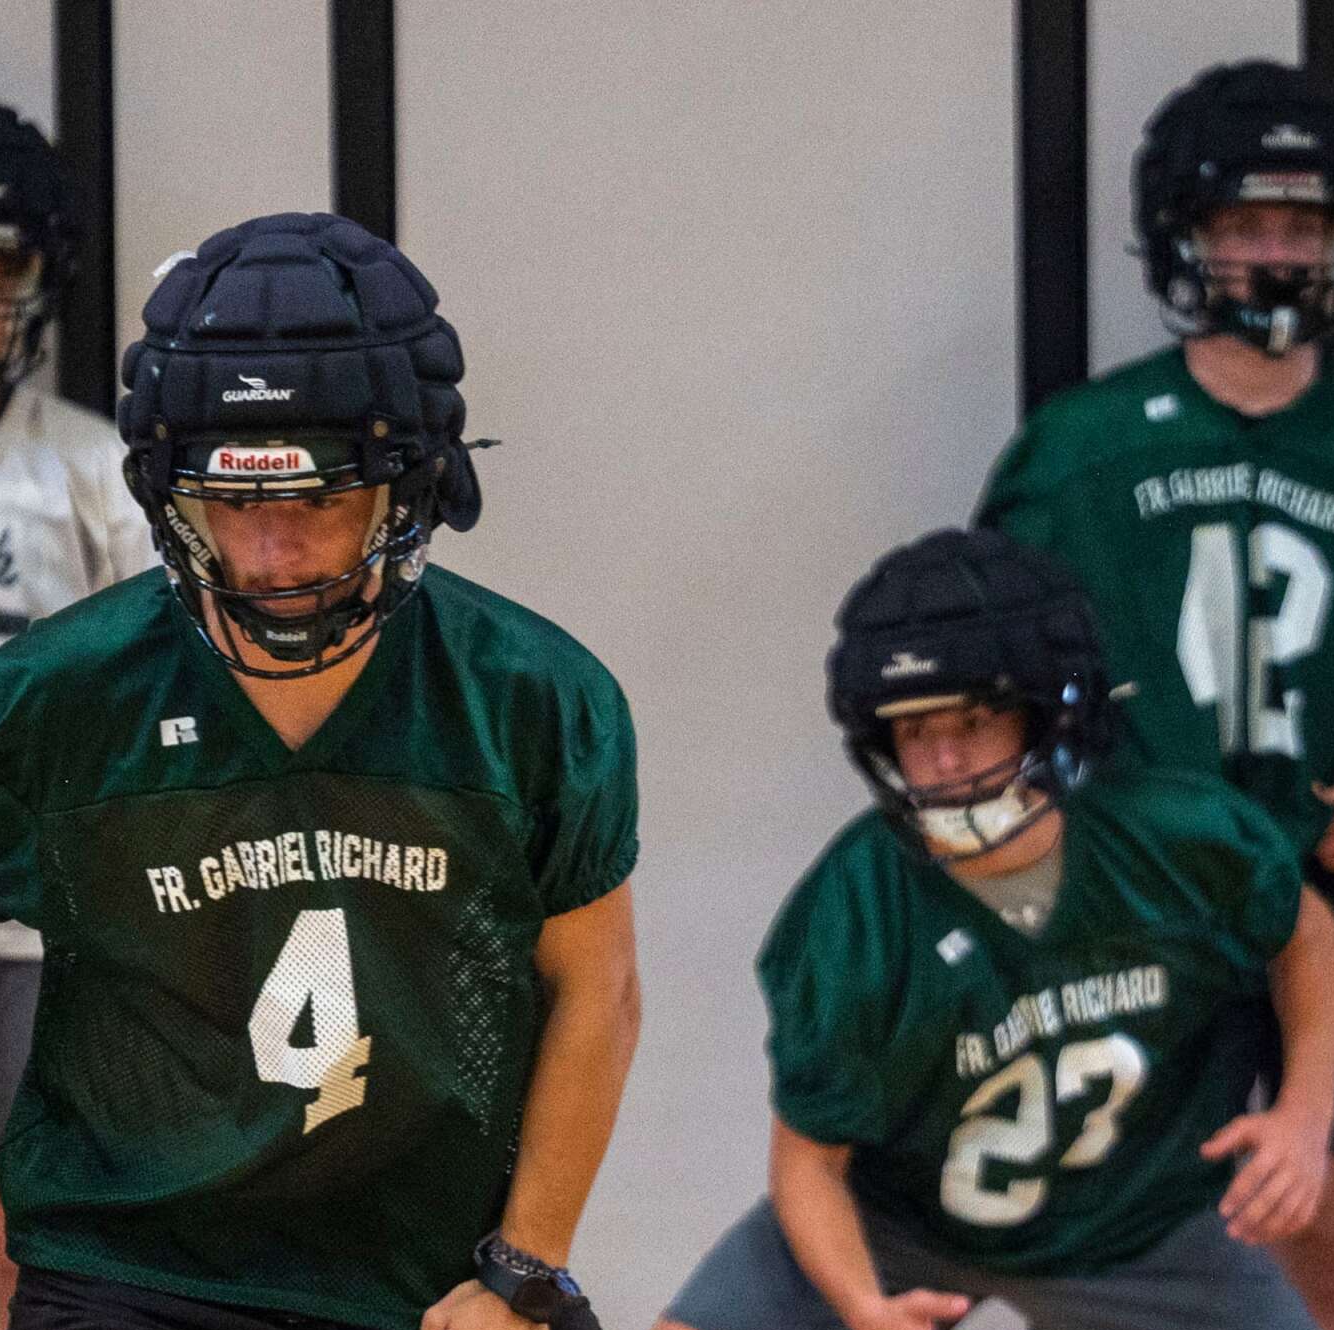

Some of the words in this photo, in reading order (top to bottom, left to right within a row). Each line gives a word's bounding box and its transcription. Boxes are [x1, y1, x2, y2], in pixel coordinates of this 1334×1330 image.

[222, 389, 292, 402] GUARDIAN
[219, 452, 300, 472] Riddell
[164, 503, 212, 564] Riddell
[146, 864, 200, 913] FR.
[199, 831, 316, 900] GABRIEL
[315, 830, 448, 892] RICHARD
[247, 906, 372, 1136] 4
